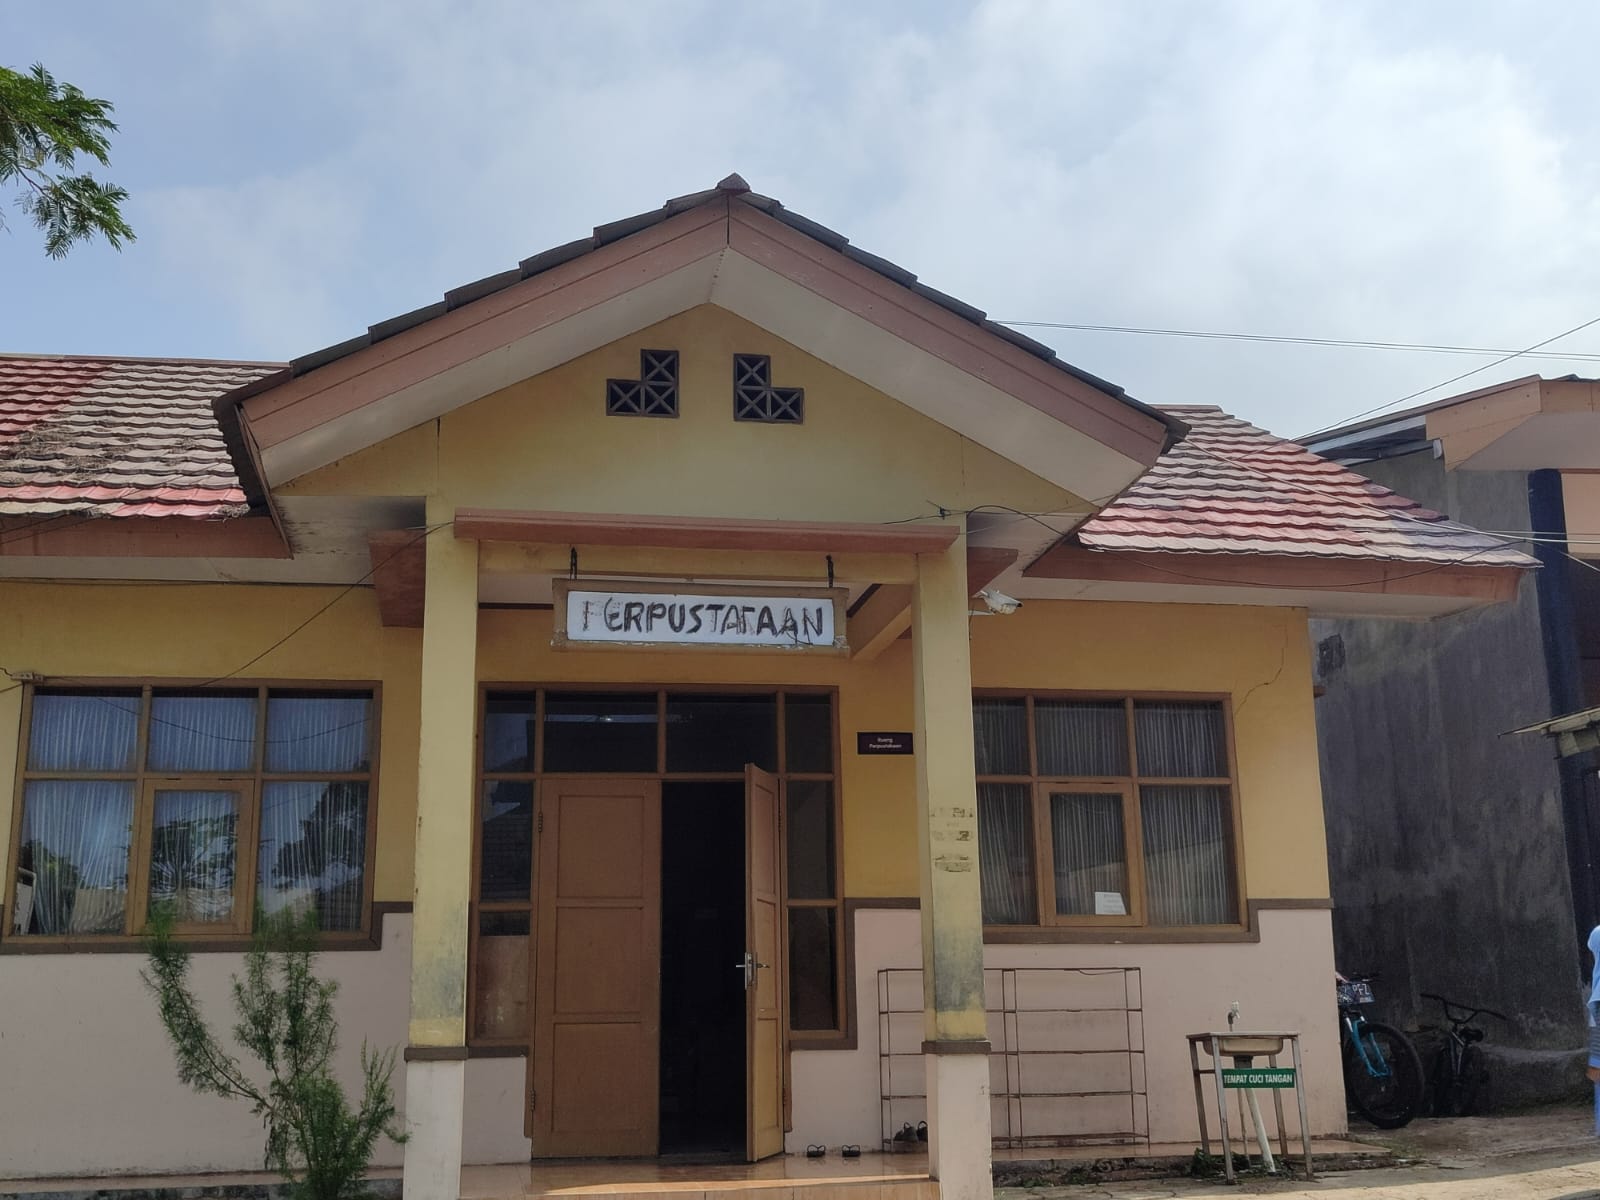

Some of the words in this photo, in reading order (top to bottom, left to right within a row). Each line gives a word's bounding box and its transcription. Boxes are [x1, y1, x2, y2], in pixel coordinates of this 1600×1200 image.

[1224, 1074, 1247, 1083] TEMPAT
[1249, 1074, 1264, 1083] CUCI
[1265, 1073, 1293, 1083] TANGAN
